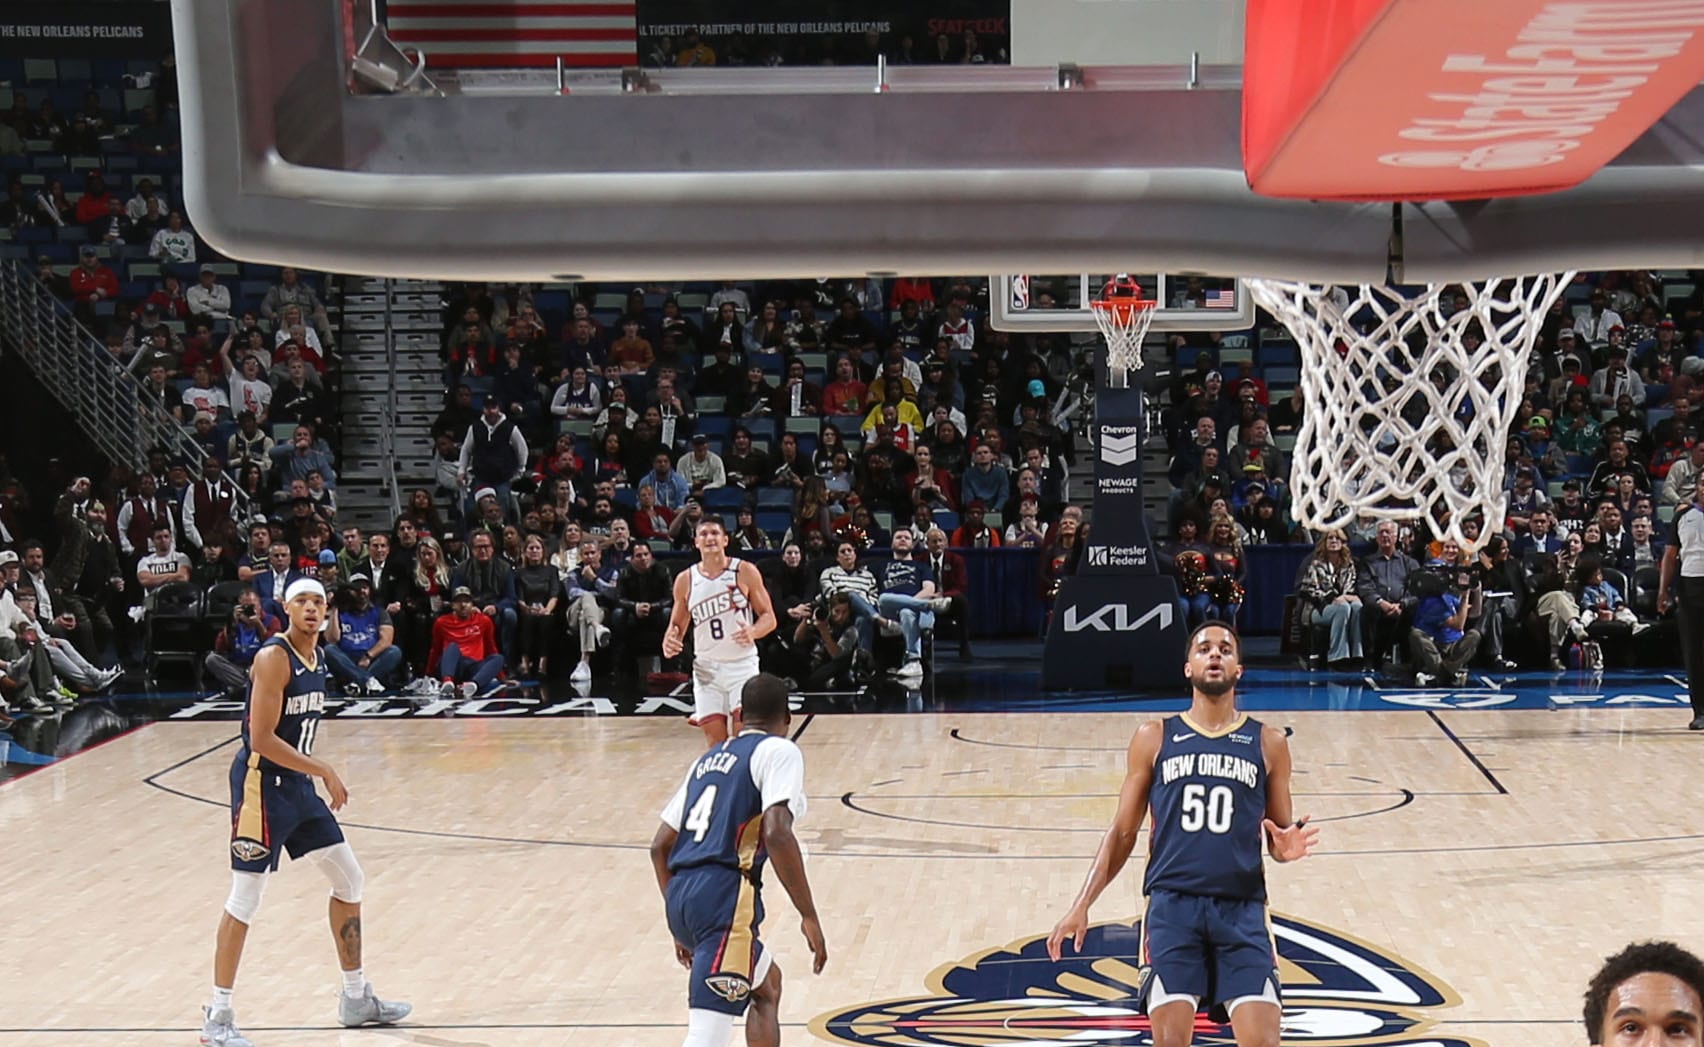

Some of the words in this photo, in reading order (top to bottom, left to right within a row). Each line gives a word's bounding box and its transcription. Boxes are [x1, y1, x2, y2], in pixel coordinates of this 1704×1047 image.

[17, 25, 41, 37] NEW
[42, 25, 91, 37] ORLEANS
[92, 26, 144, 38] PELICANS
[744, 23, 756, 34] OF
[757, 23, 776, 34] THE
[777, 22, 798, 34] NEW
[799, 22, 843, 34] ORLEANS
[1101, 425, 1137, 434] Chevron
[1099, 478, 1138, 488] NEWAGE
[1109, 546, 1148, 556] Keesler
[1109, 556, 1147, 566] Federal
[692, 593, 731, 628] SUNS
[709, 618, 724, 640] 8
[298, 718, 317, 756] 11
[696, 752, 738, 780] GREEN
[1162, 753, 1196, 786] NEW
[1198, 753, 1259, 789] ORLEANS
[685, 784, 718, 843] 4
[1181, 784, 1234, 834] 50
